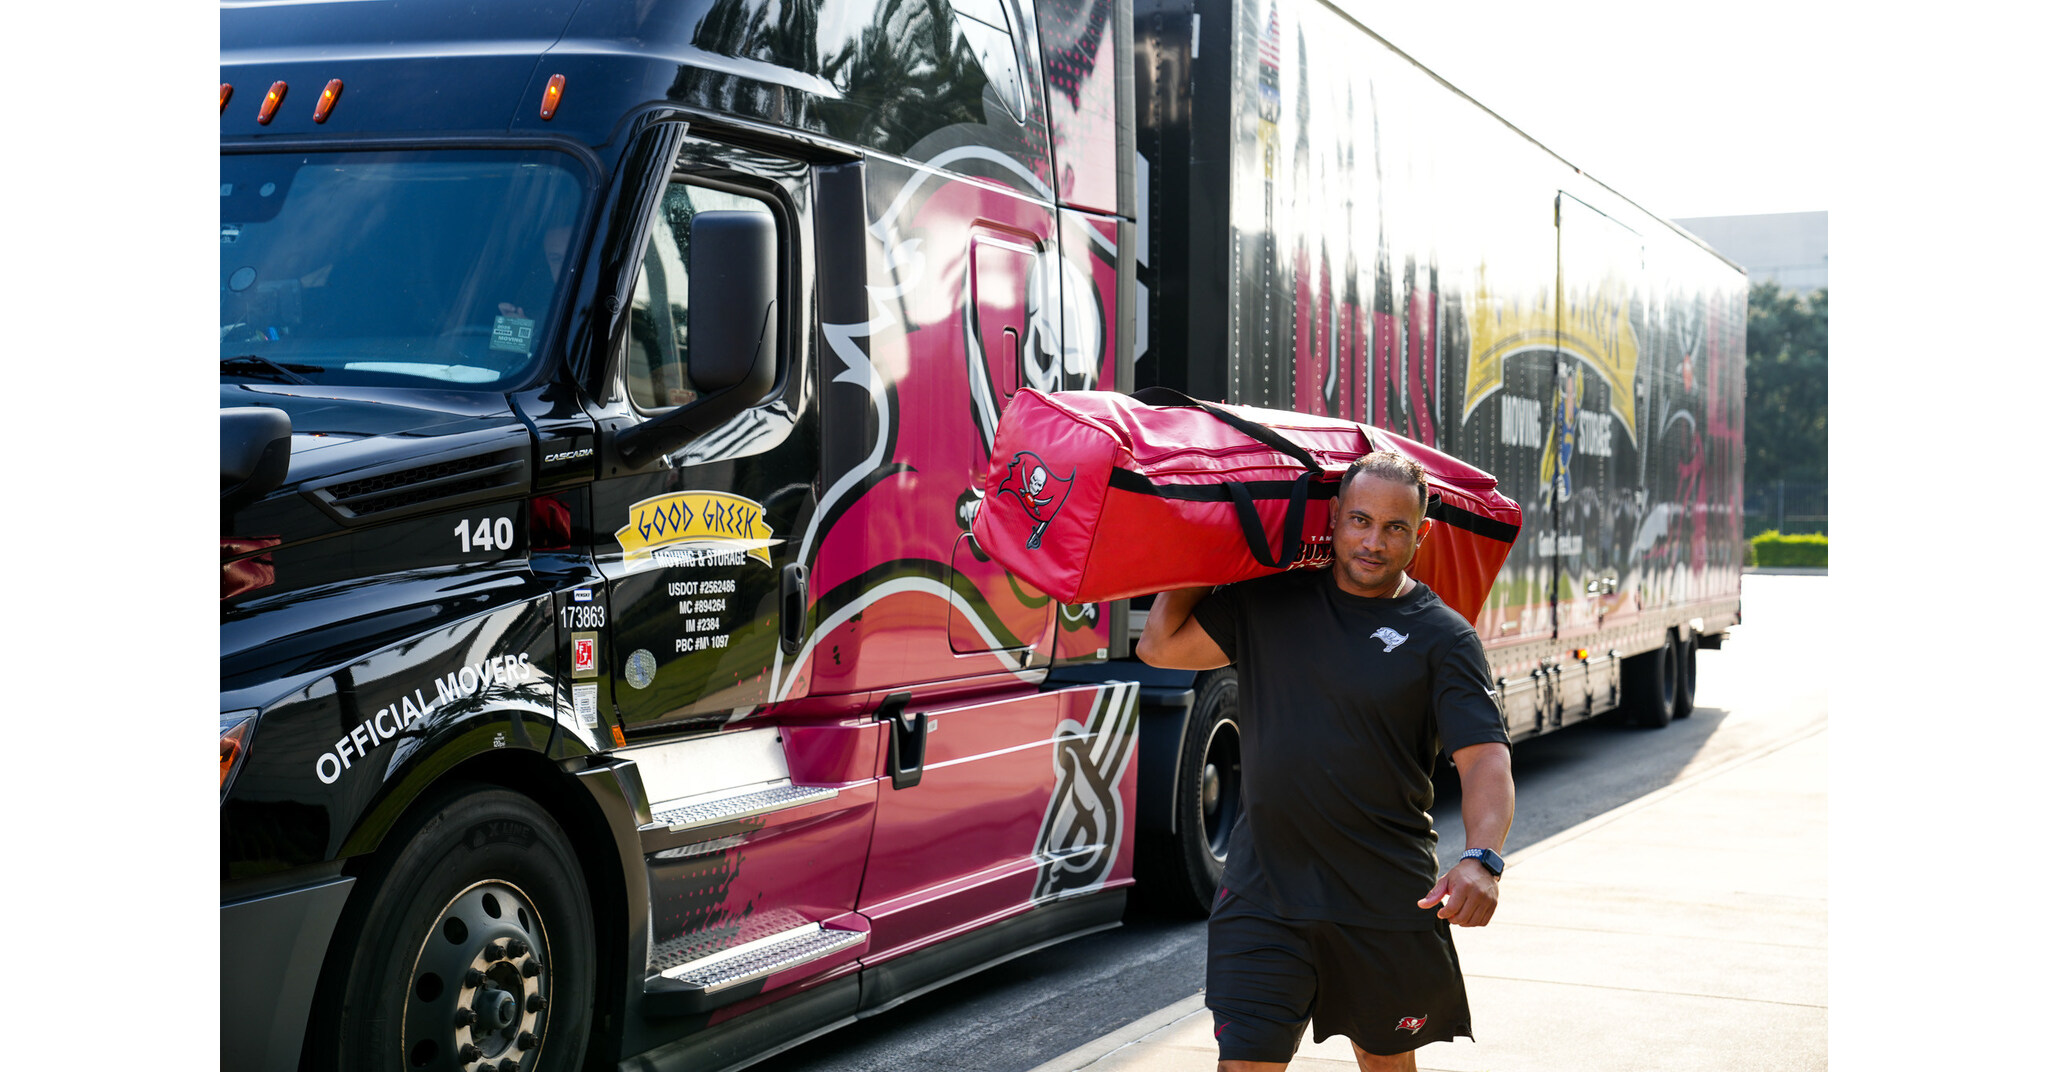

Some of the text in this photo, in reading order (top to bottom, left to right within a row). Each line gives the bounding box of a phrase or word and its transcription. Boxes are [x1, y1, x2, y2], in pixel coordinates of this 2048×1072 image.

[498, 335, 523, 343] MOVING
[1501, 394, 1542, 450] MOVING
[544, 448, 594, 463] CASCADIA
[638, 499, 758, 543] GOOD GREEK
[454, 516, 514, 553] 140
[655, 549, 747, 568] MOVING & STORAGE
[668, 579, 736, 596] USDOT #2562486
[679, 598, 726, 614] MC #894264
[560, 605, 605, 628] 173863
[685, 617, 720, 632] IM #2384
[675, 638, 694, 653] PBC
[316, 688, 435, 785] OFFICIAL
[434, 652, 532, 706] MOVERS
